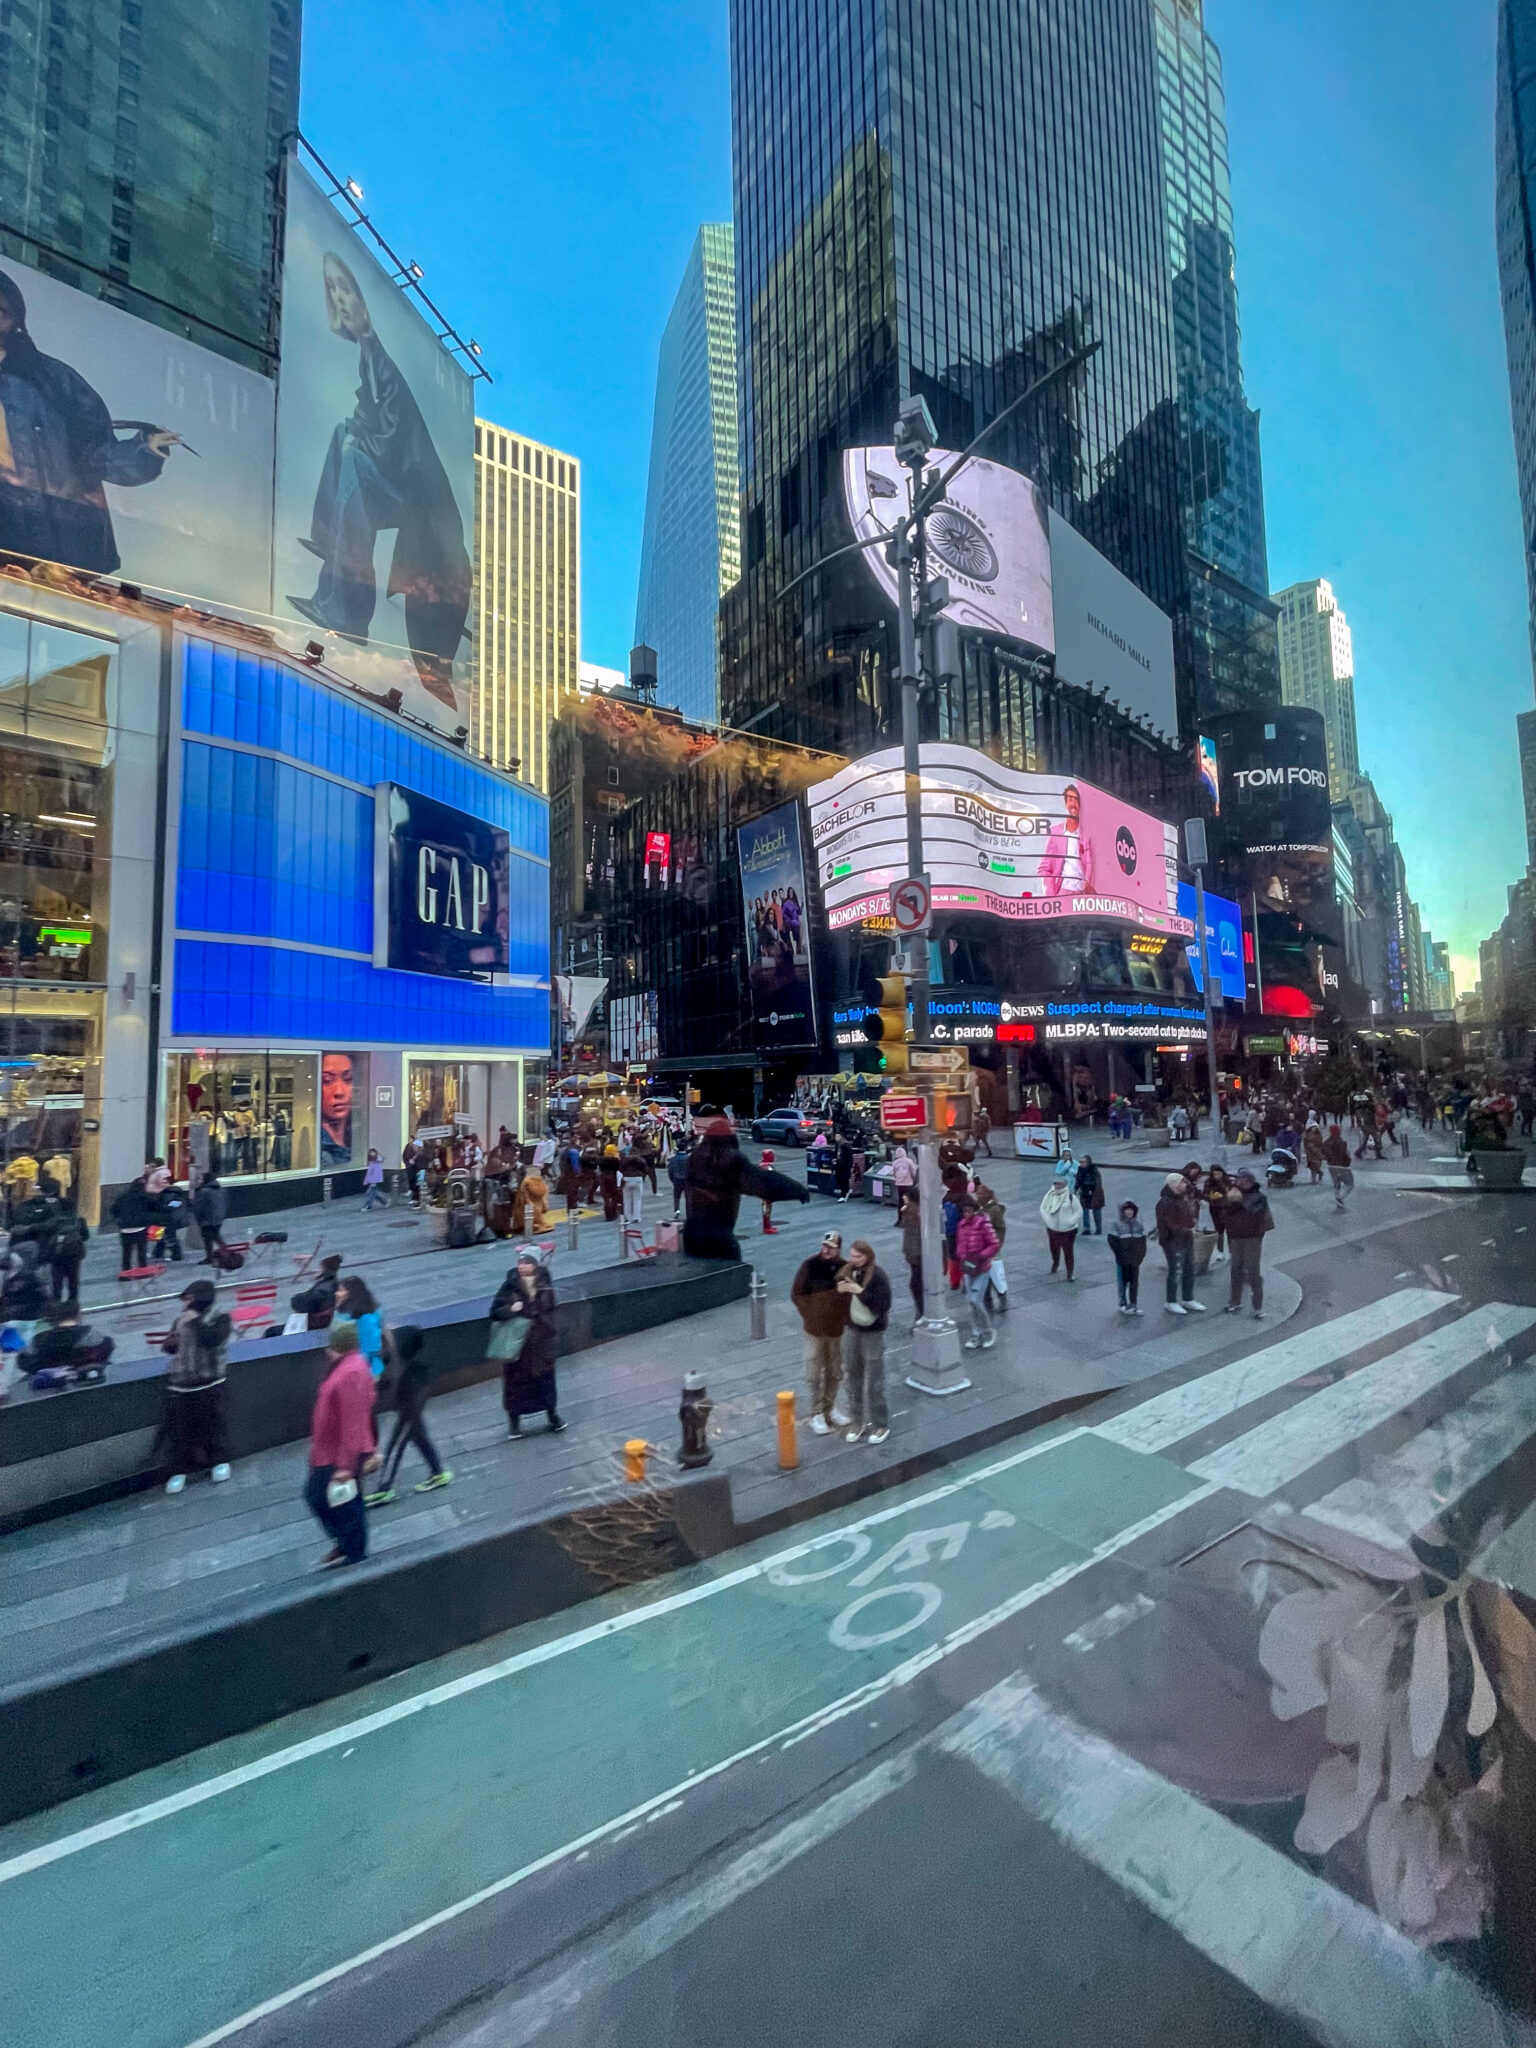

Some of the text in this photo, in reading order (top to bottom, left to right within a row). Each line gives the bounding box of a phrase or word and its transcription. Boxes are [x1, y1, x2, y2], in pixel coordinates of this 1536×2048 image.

[1087, 611, 1152, 672] RICHARD MILLE
[1233, 767, 1327, 788] TOM FORD
[814, 801, 876, 840] BACHELOR
[953, 796, 1052, 835] BACHELOR
[752, 826, 786, 857] Abbott
[1117, 839, 1136, 860] abc
[1246, 845, 1277, 854] WATCH
[1277, 844, 1287, 853] AT
[418, 846, 489, 934] GAP
[829, 897, 891, 927] MONDAYS 8/7c
[985, 894, 1062, 916] THE BACHELOR
[1072, 897, 1127, 915] MONDAYS
[1169, 918, 1182, 931] THE
[928, 1000, 970, 1015] lloon':
[1012, 1005, 1045, 1017] NEWS
[1047, 1002, 1101, 1016] Suspect
[1103, 1002, 1143, 1017] charged
[929, 1024, 951, 1038] .C.
[954, 1026, 993, 1041] parade
[1046, 1023, 1100, 1037] MLBPA:
[1101, 1023, 1159, 1036] Two-second
[1160, 1026, 1171, 1037] cut
[1171, 1027, 1178, 1037] to
